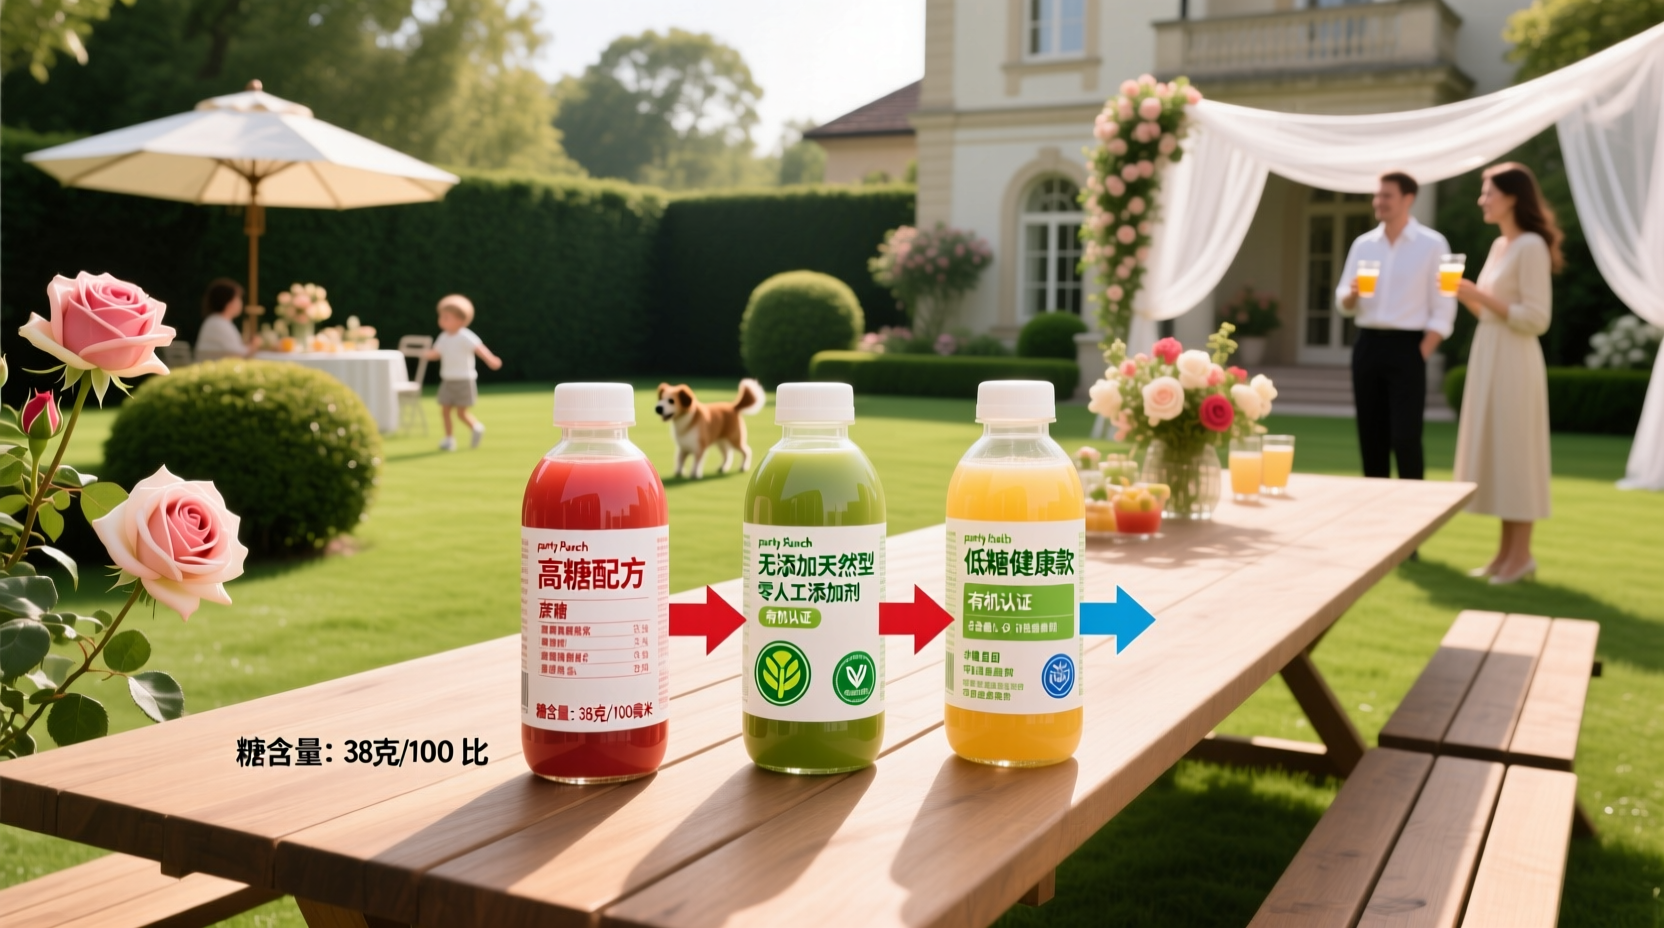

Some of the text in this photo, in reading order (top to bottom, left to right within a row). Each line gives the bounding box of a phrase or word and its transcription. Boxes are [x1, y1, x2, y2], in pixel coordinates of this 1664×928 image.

[537, 556, 646, 591] 高糖配方
[758, 551, 875, 578] 无添加天然型
[963, 547, 1075, 577] 低糖健康款
[758, 581, 861, 604] 零人工添加剂
[967, 590, 1033, 612] 有机认证
